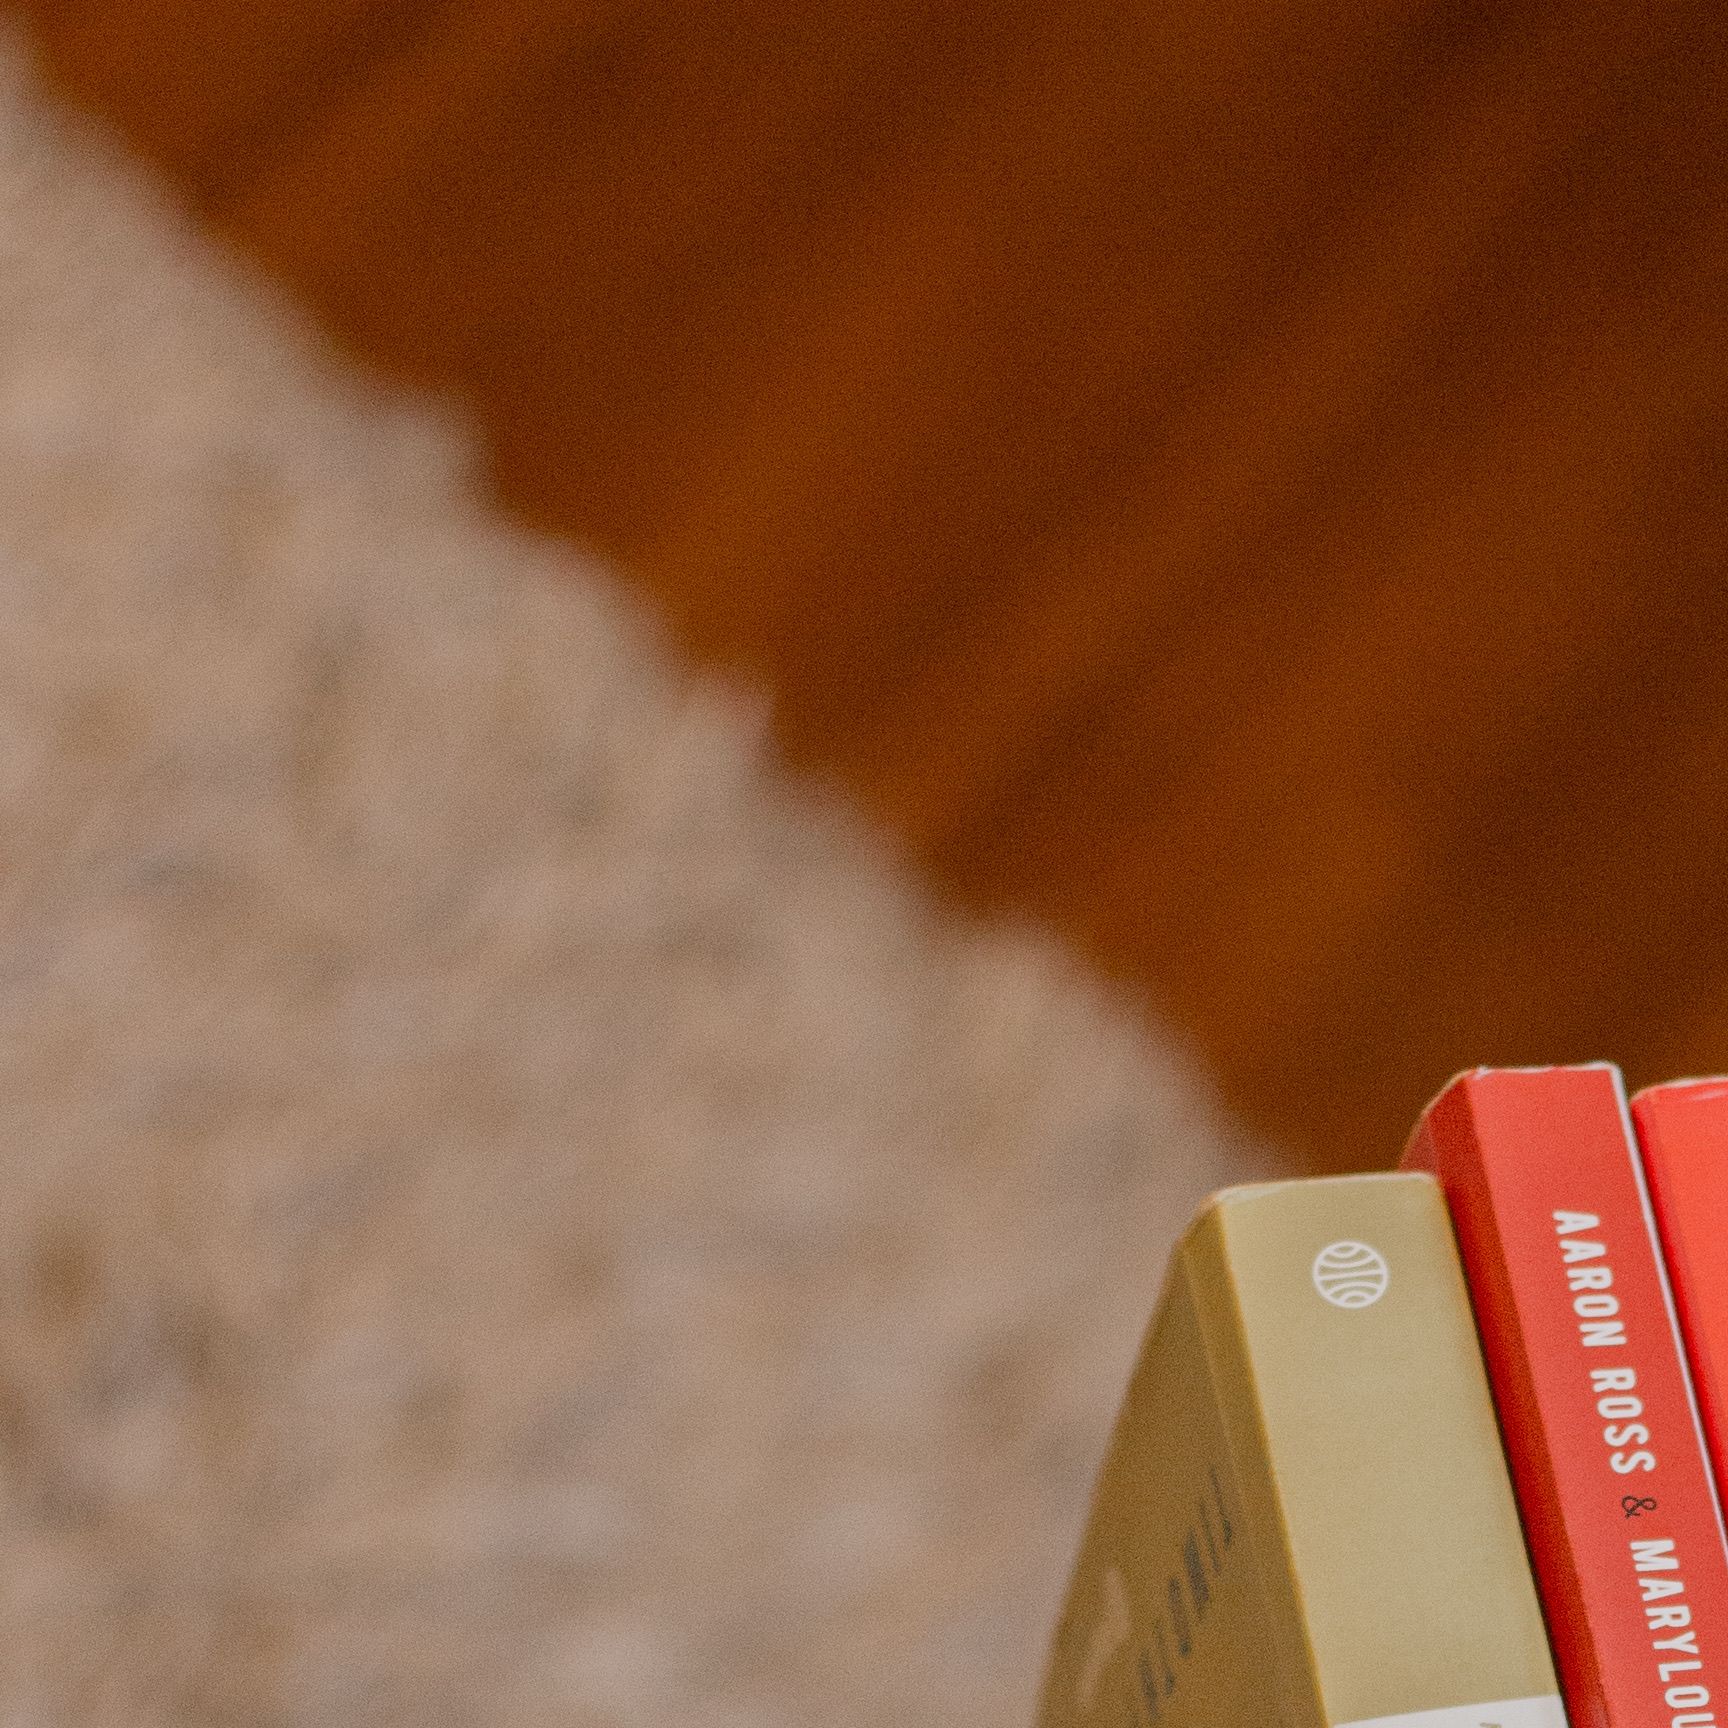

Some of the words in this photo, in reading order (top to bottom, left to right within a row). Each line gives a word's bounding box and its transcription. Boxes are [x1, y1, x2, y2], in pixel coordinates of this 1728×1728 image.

[1553, 1210, 1627, 1346] AARON
[1590, 1366, 1656, 1475] ROSS
[1621, 1495, 1657, 1518] &
